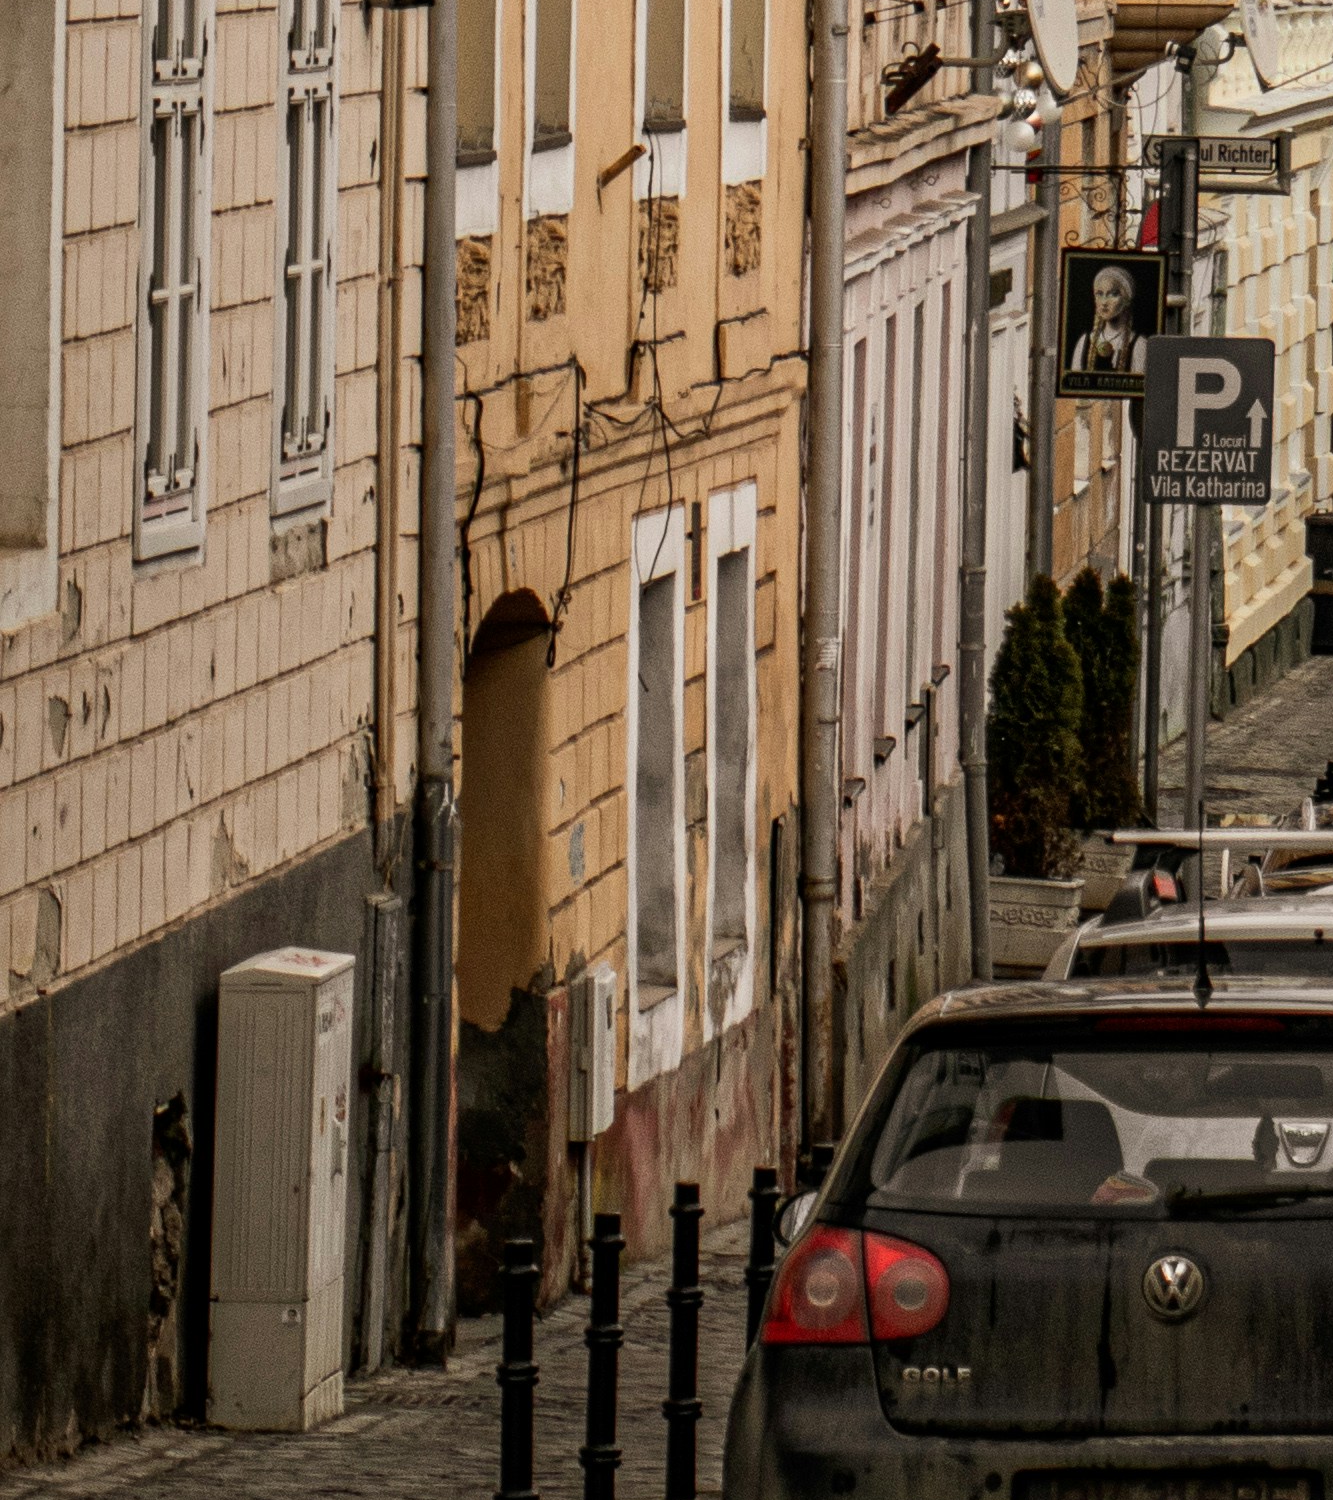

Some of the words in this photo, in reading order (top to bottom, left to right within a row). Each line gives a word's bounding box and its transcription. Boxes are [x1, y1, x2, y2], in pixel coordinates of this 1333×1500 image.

[1217, 143, 1268, 163] Richter
[1176, 357, 1242, 448] P
[1202, 433, 1211, 448] 3
[1213, 433, 1247, 448] Locuri
[1157, 450, 1259, 473] REZERVAT
[1151, 475, 1181, 498] Vila
[1186, 475, 1266, 499] Katharina
